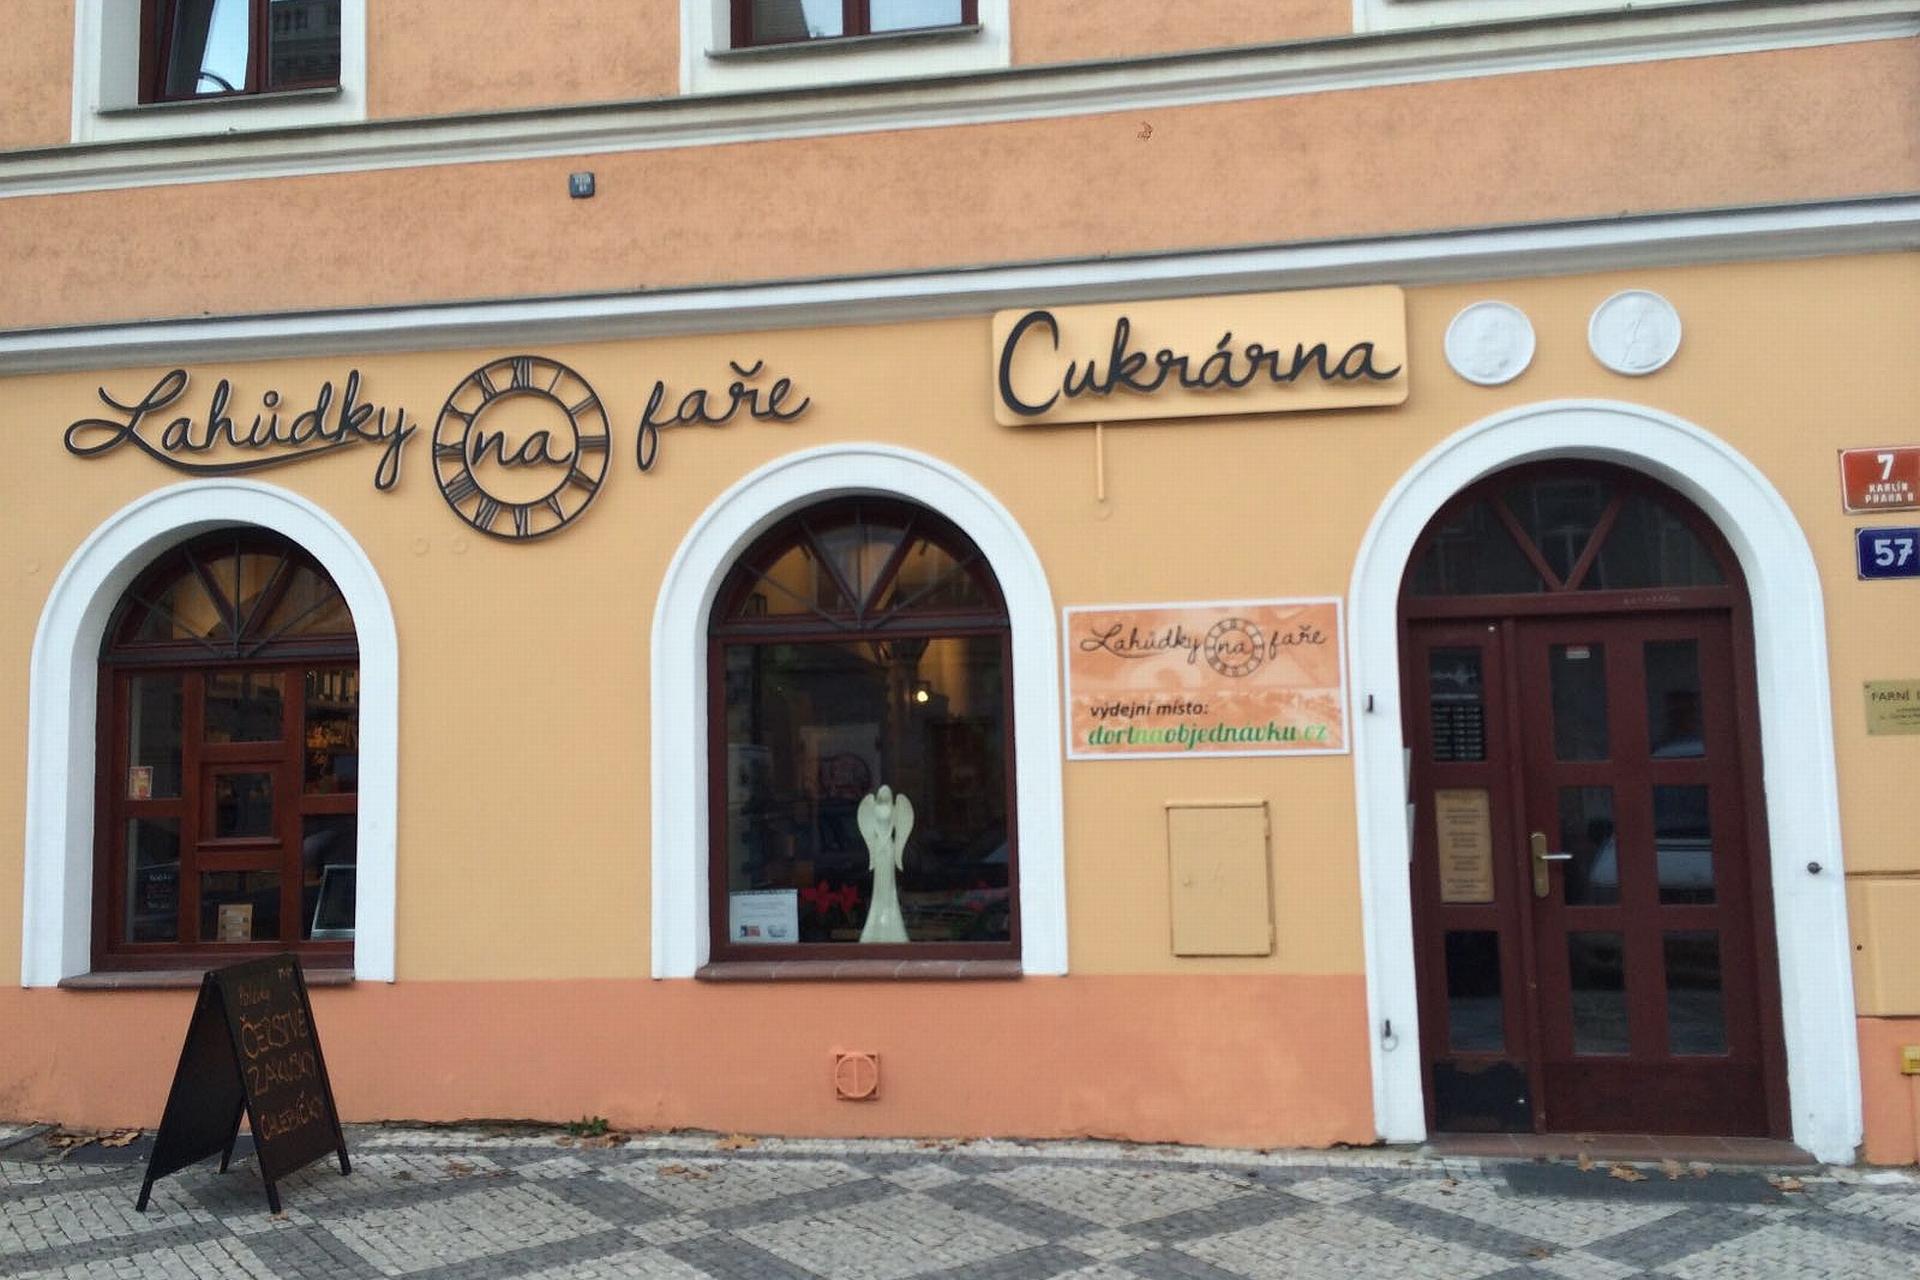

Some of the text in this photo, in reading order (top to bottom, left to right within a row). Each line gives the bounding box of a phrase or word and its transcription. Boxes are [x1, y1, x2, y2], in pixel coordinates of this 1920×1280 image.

[1000, 310, 1402, 416] Cukrárna
[64, 360, 811, 492] Lahůdky na faře
[1877, 453, 1895, 481] 7
[1864, 493, 1903, 504] PRAHA
[1874, 538, 1914, 567] 57
[1080, 624, 1327, 664] Lahůdky na faře
[1090, 699, 1209, 719] výdejní místo:
